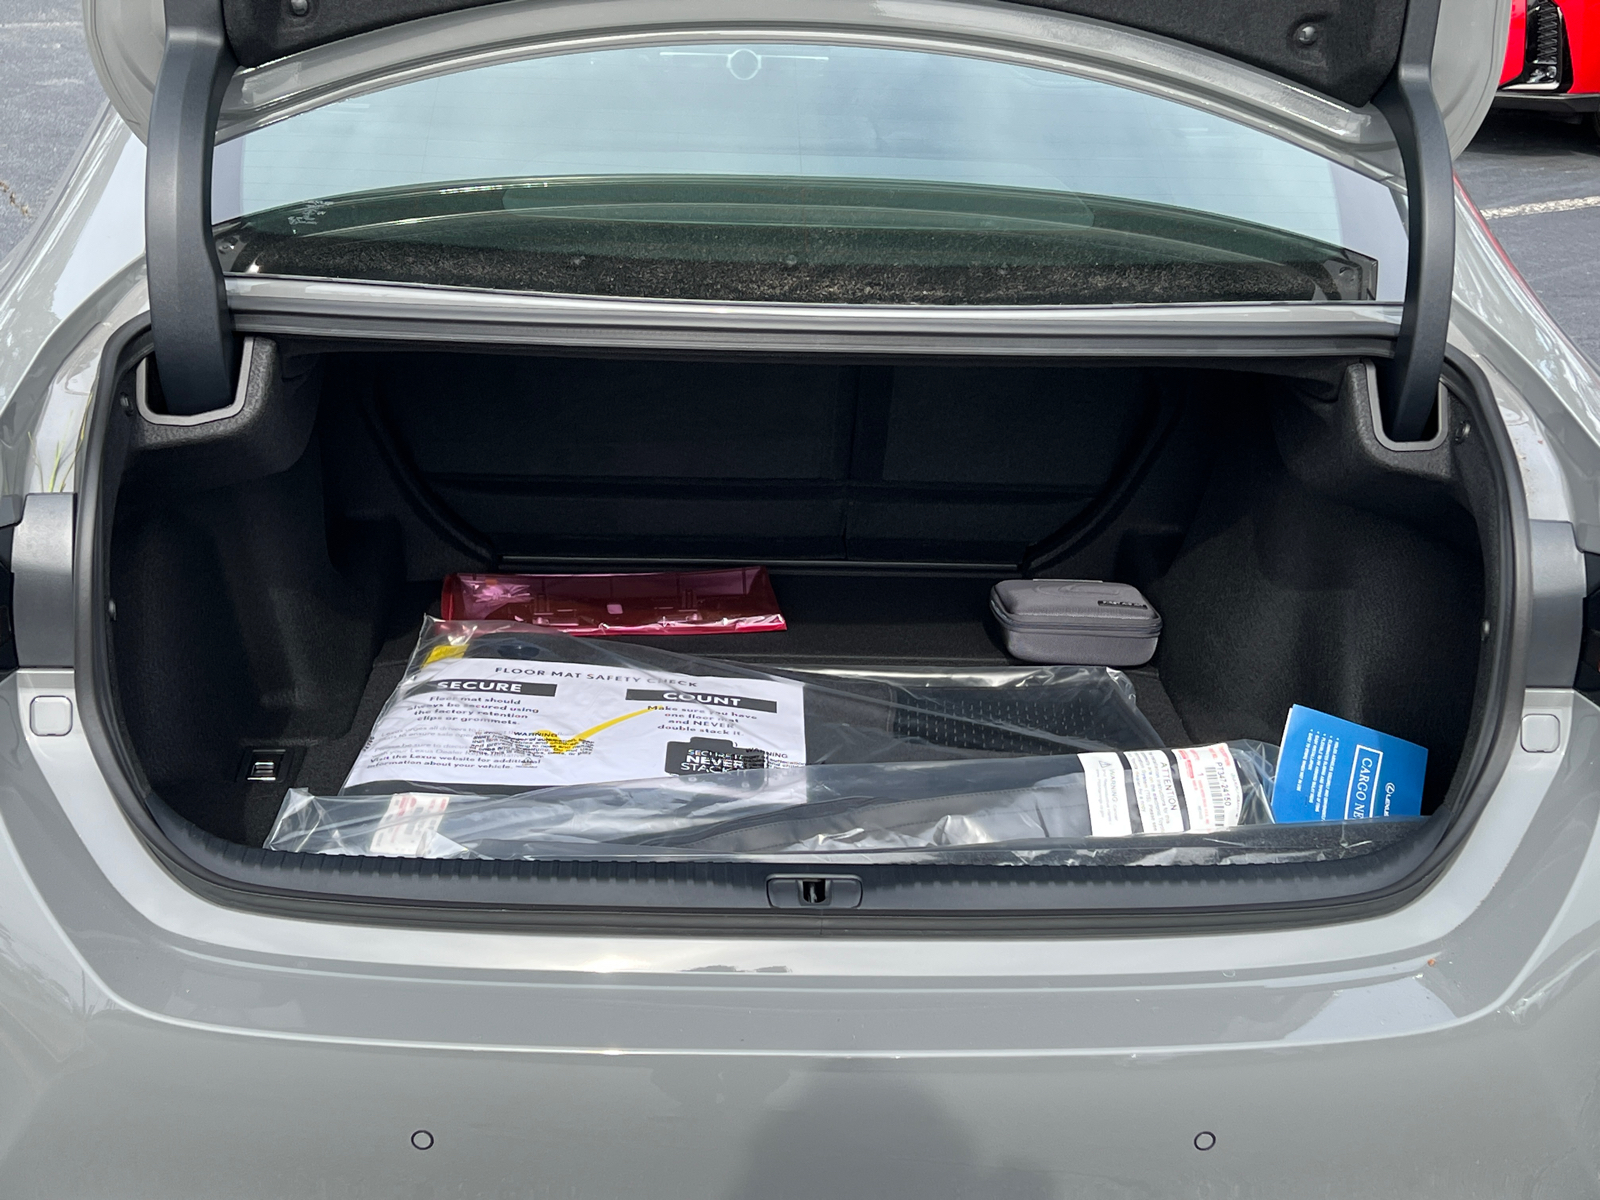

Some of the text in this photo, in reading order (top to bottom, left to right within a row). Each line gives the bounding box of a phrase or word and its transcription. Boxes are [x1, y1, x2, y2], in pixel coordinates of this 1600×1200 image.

[438, 682, 522, 692] SECURE
[587, 674, 640, 683] SAFETY
[647, 678, 698, 687] CHECK
[663, 693, 740, 706] COUNT
[681, 762, 732, 774] STACK
[686, 755, 744, 768] NEVER
[1160, 762, 1177, 810] ATTENTION
[1356, 758, 1372, 801] CARGO
[1157, 779, 1166, 806] instructions
[1153, 793, 1161, 816] electronic
